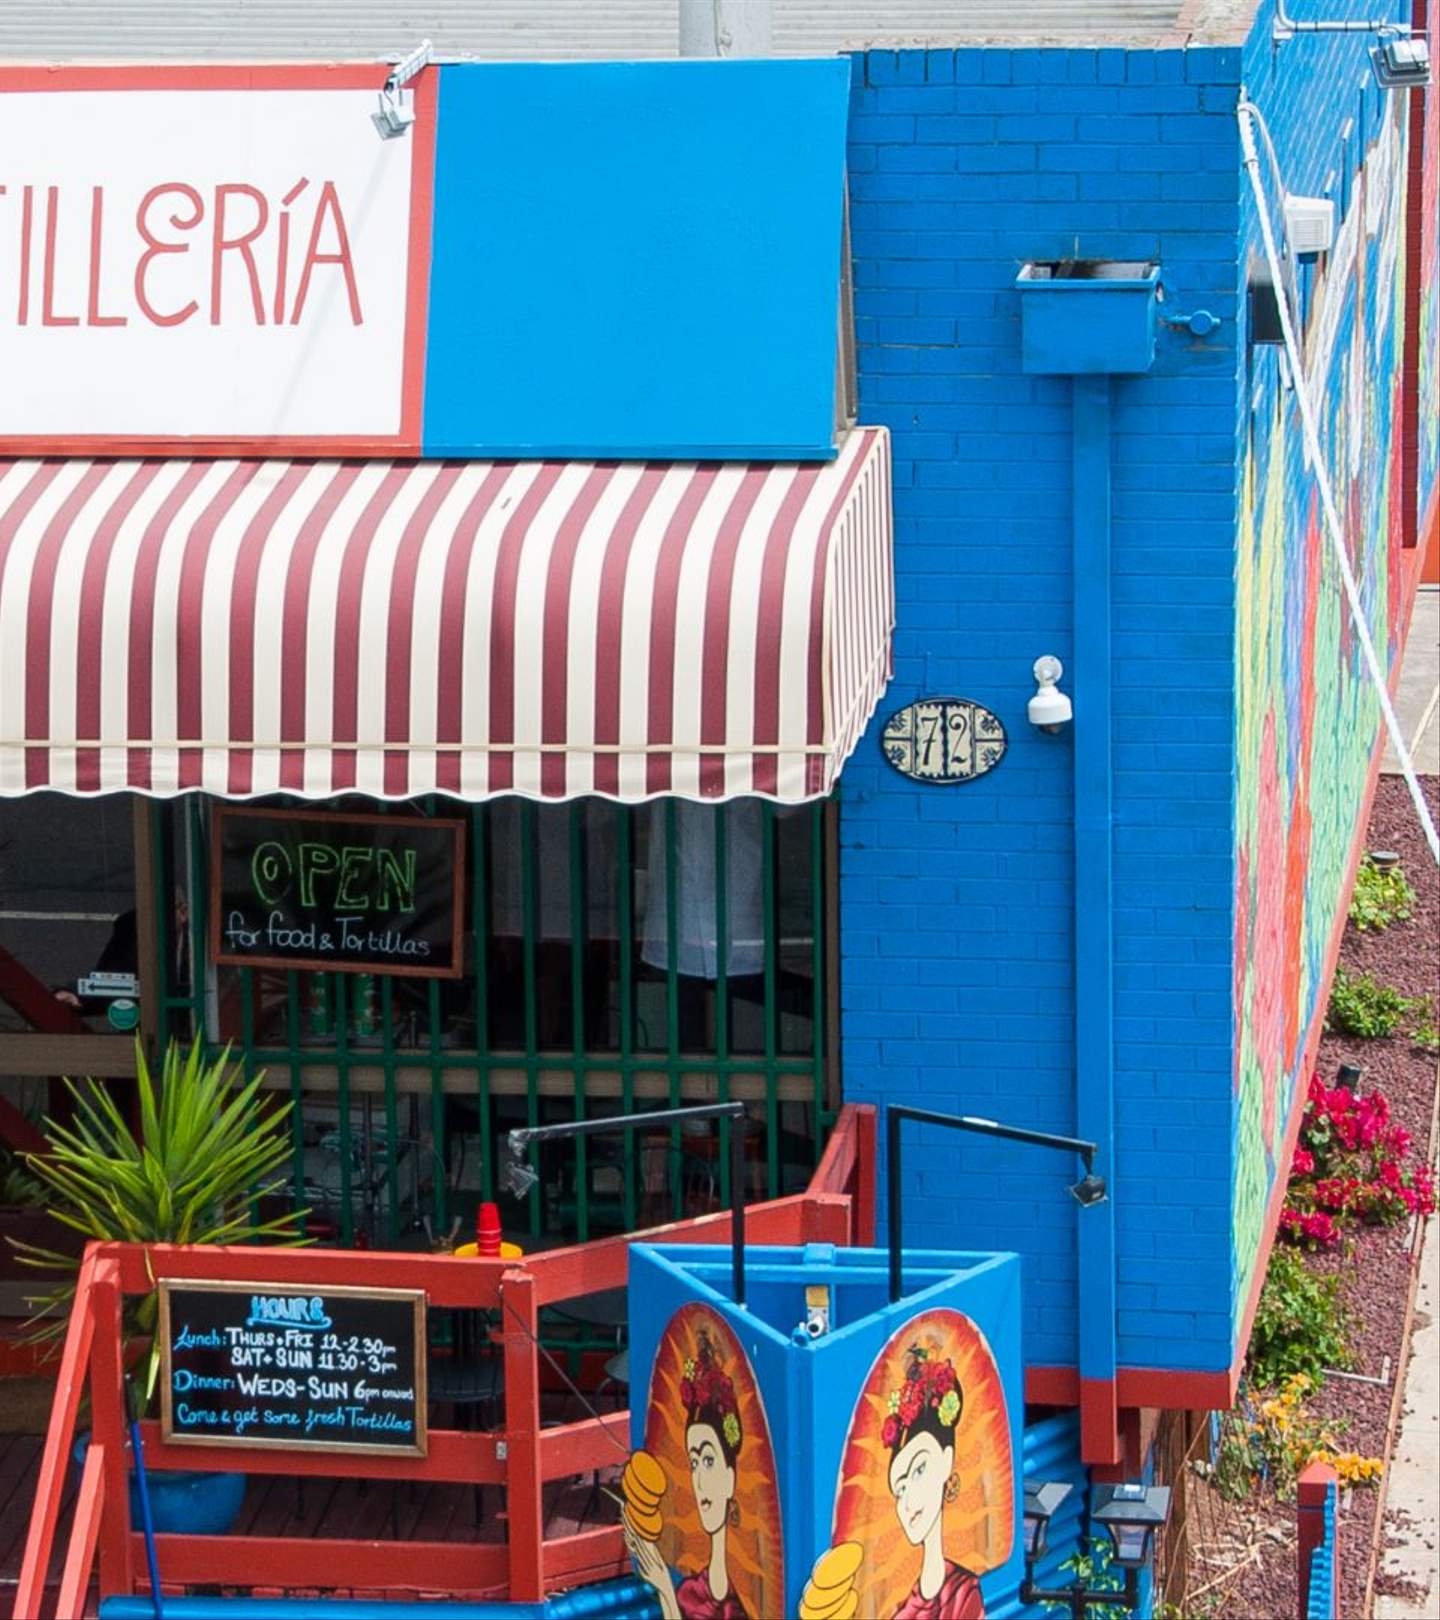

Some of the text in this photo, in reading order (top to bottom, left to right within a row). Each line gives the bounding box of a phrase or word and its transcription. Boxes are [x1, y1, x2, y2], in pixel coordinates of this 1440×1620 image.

[920, 712, 968, 767] 72
[251, 840, 417, 913] OPEN
[226, 909, 432, 957] for food & Tortillas
[250, 1295, 325, 1322] HOURS
[172, 1324, 227, 1351] Lunch:
[173, 1369, 236, 1392] Dinner:
[177, 1402, 218, 1425] Come
[232, 1406, 260, 1434] get
[305, 1405, 346, 1433] fresh
[344, 1406, 414, 1431] Tortillas
